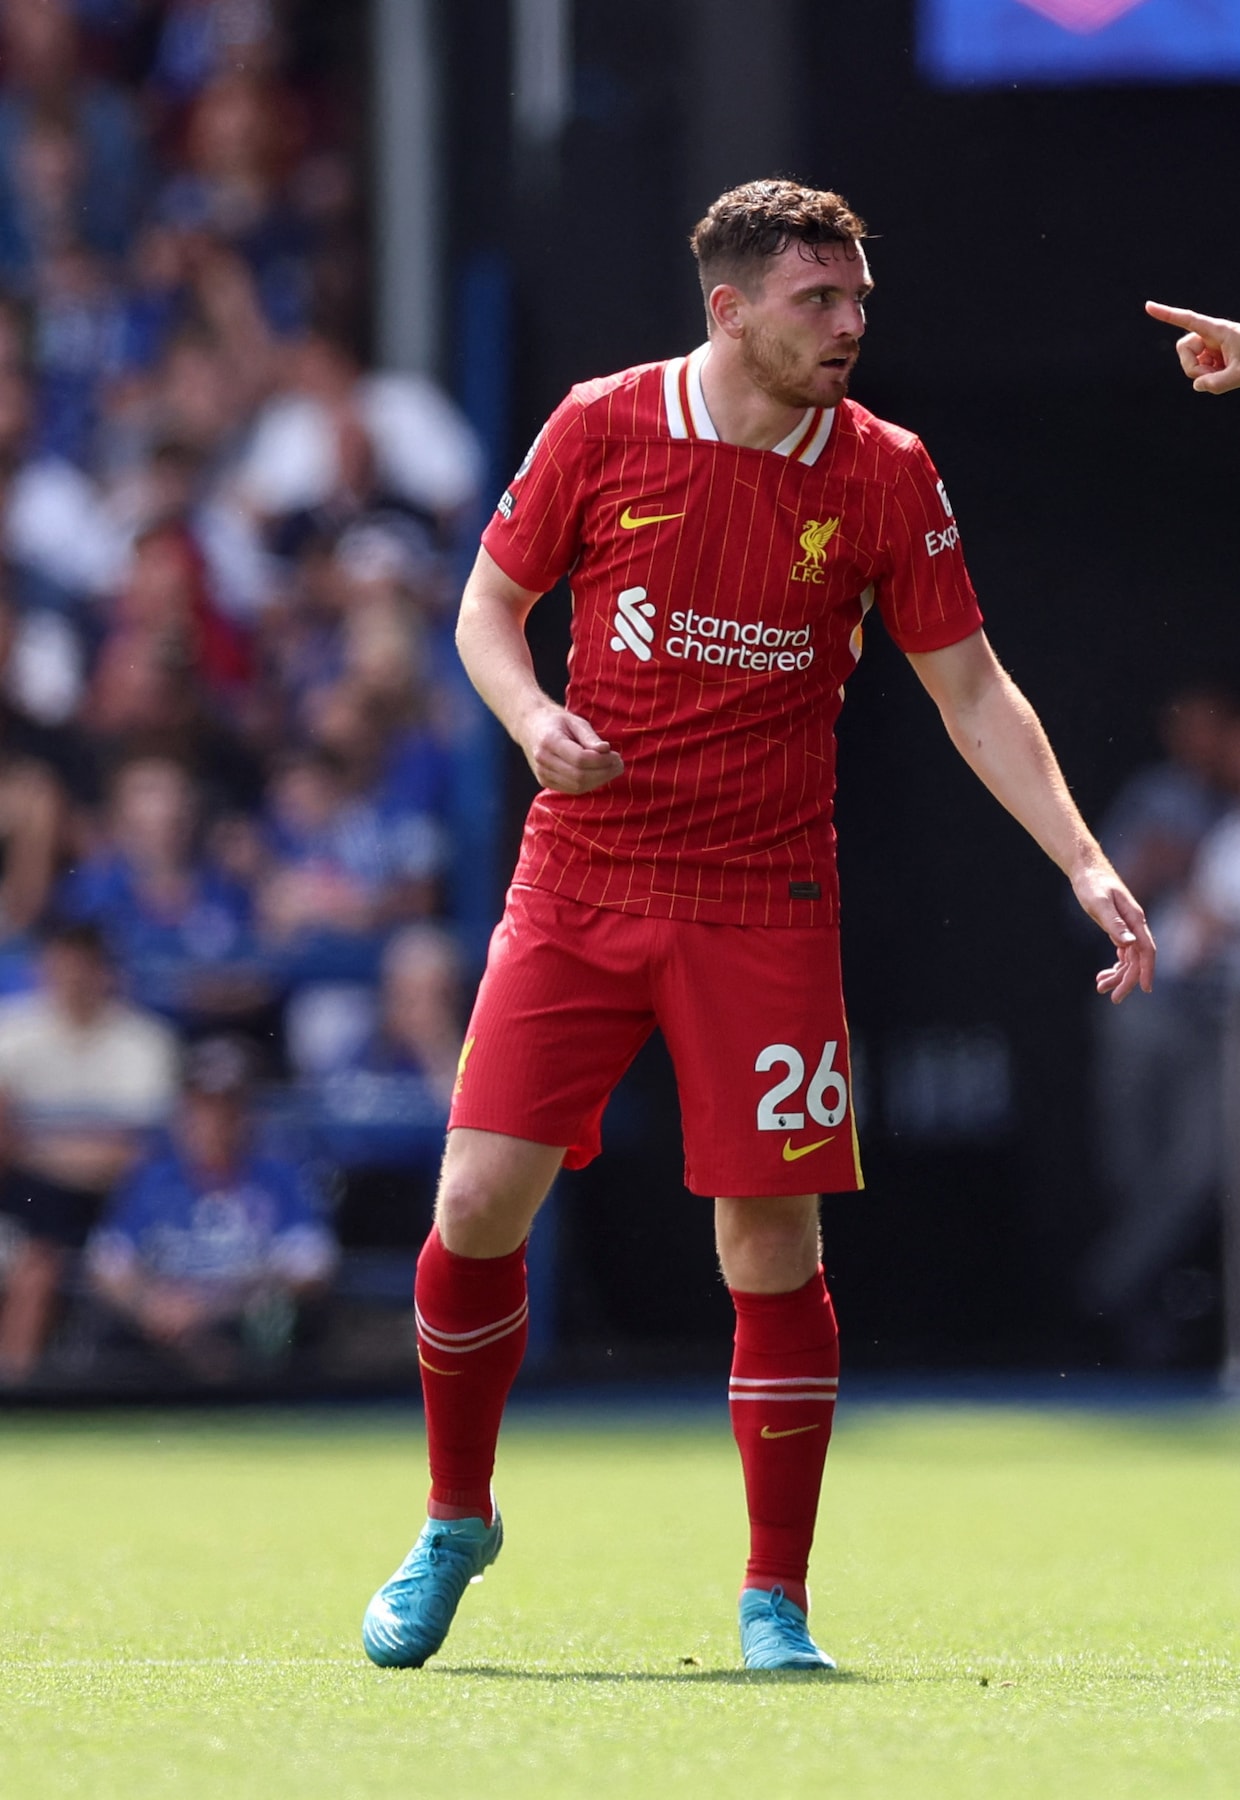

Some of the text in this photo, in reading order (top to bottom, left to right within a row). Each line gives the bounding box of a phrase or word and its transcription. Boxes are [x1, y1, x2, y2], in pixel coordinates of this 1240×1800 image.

[669, 609, 810, 648] standard
[666, 635, 814, 672] chartered
[755, 1040, 847, 1131] 26
